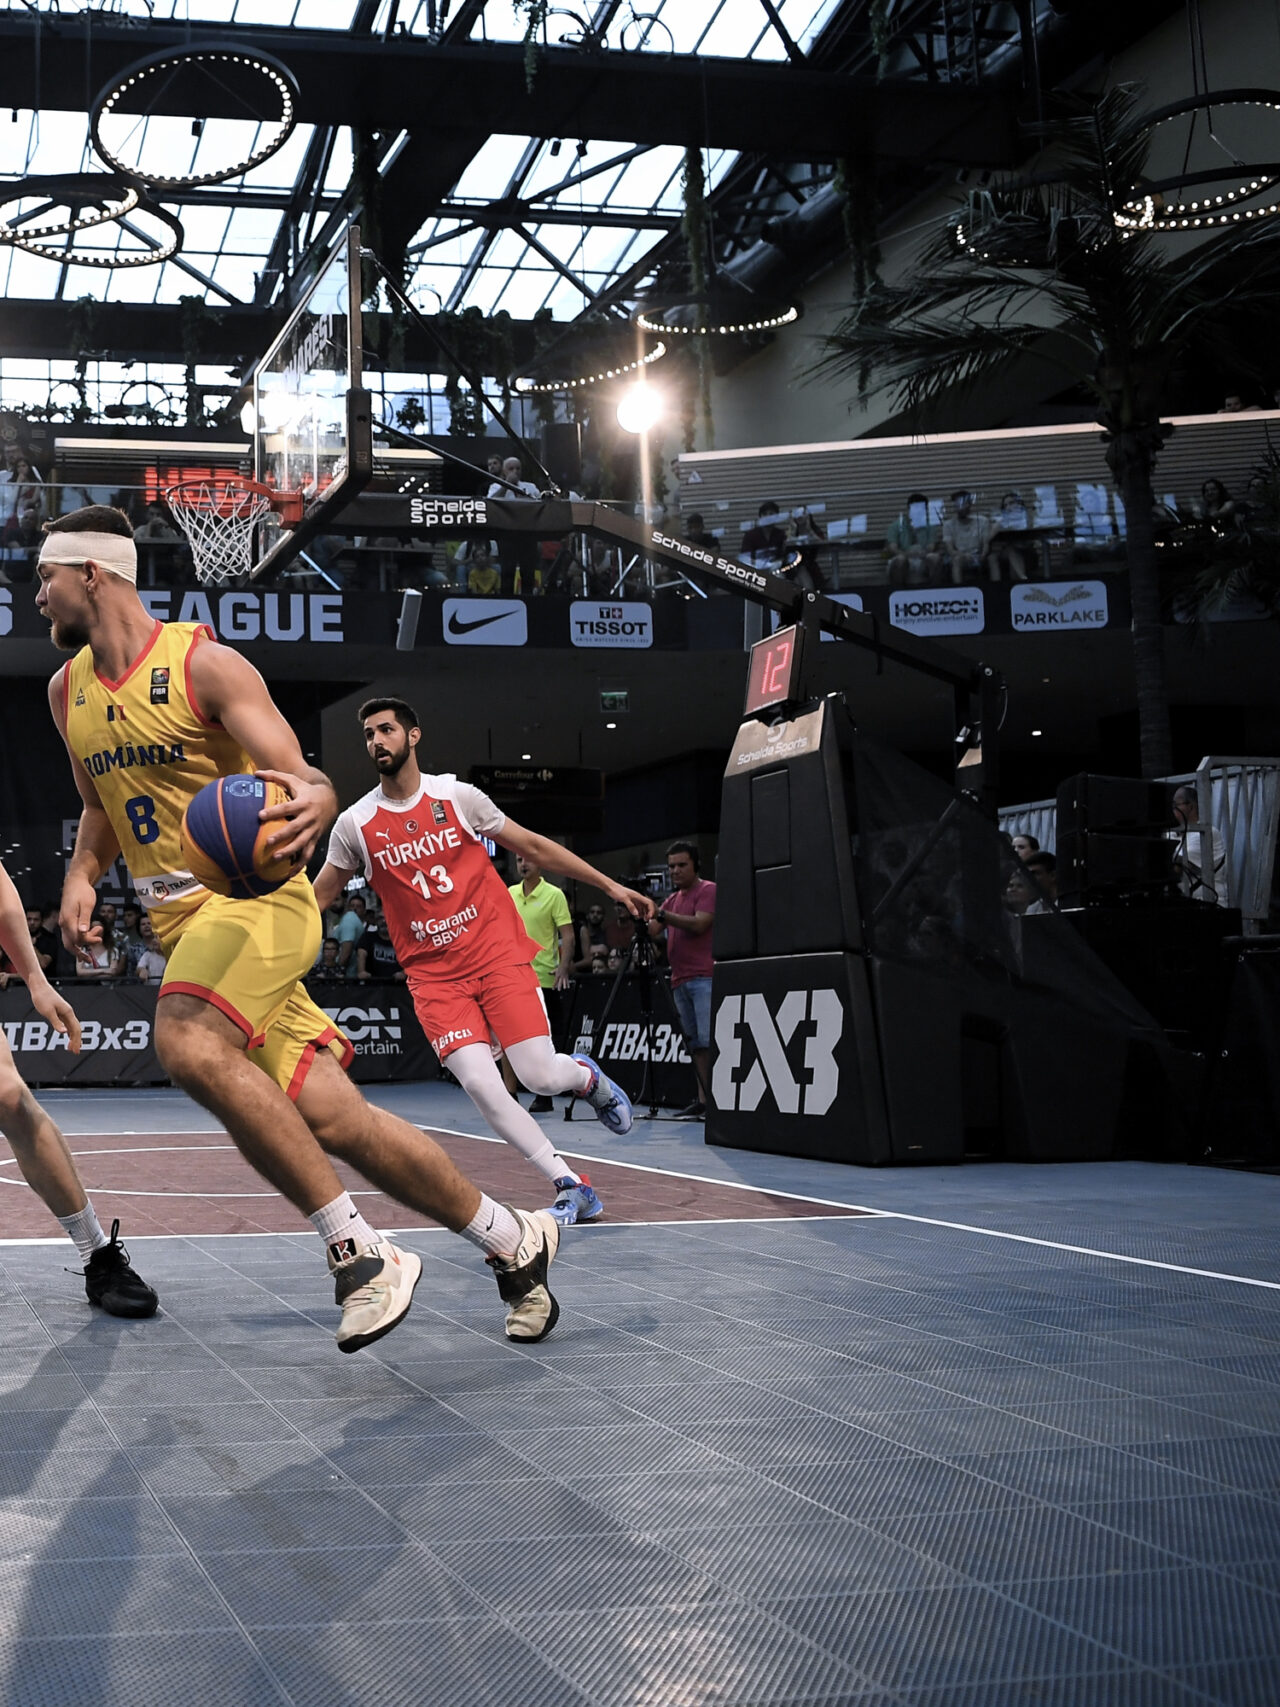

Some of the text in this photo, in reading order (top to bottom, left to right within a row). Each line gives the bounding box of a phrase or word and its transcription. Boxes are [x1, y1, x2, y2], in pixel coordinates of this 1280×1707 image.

[411, 499, 487, 512] Schelde
[411, 511, 487, 527] Sports
[716, 557, 767, 587] Sports
[138, 590, 344, 642] EAGUE
[895, 600, 978, 617] HORIZON
[1014, 610, 1105, 626] PARKLAKE
[575, 621, 648, 635] TISSOT
[761, 642, 791, 694] 12
[83, 741, 188, 778] ROMÂNIA
[125, 795, 160, 845] 8
[374, 827, 462, 870] TÜRKİYE
[411, 864, 454, 900] 13
[425, 903, 478, 935] Garanti
[431, 925, 469, 947] BBVA
[0, 1020, 150, 1051] IBA3x3
[354, 1040, 404, 1056] ertain.
